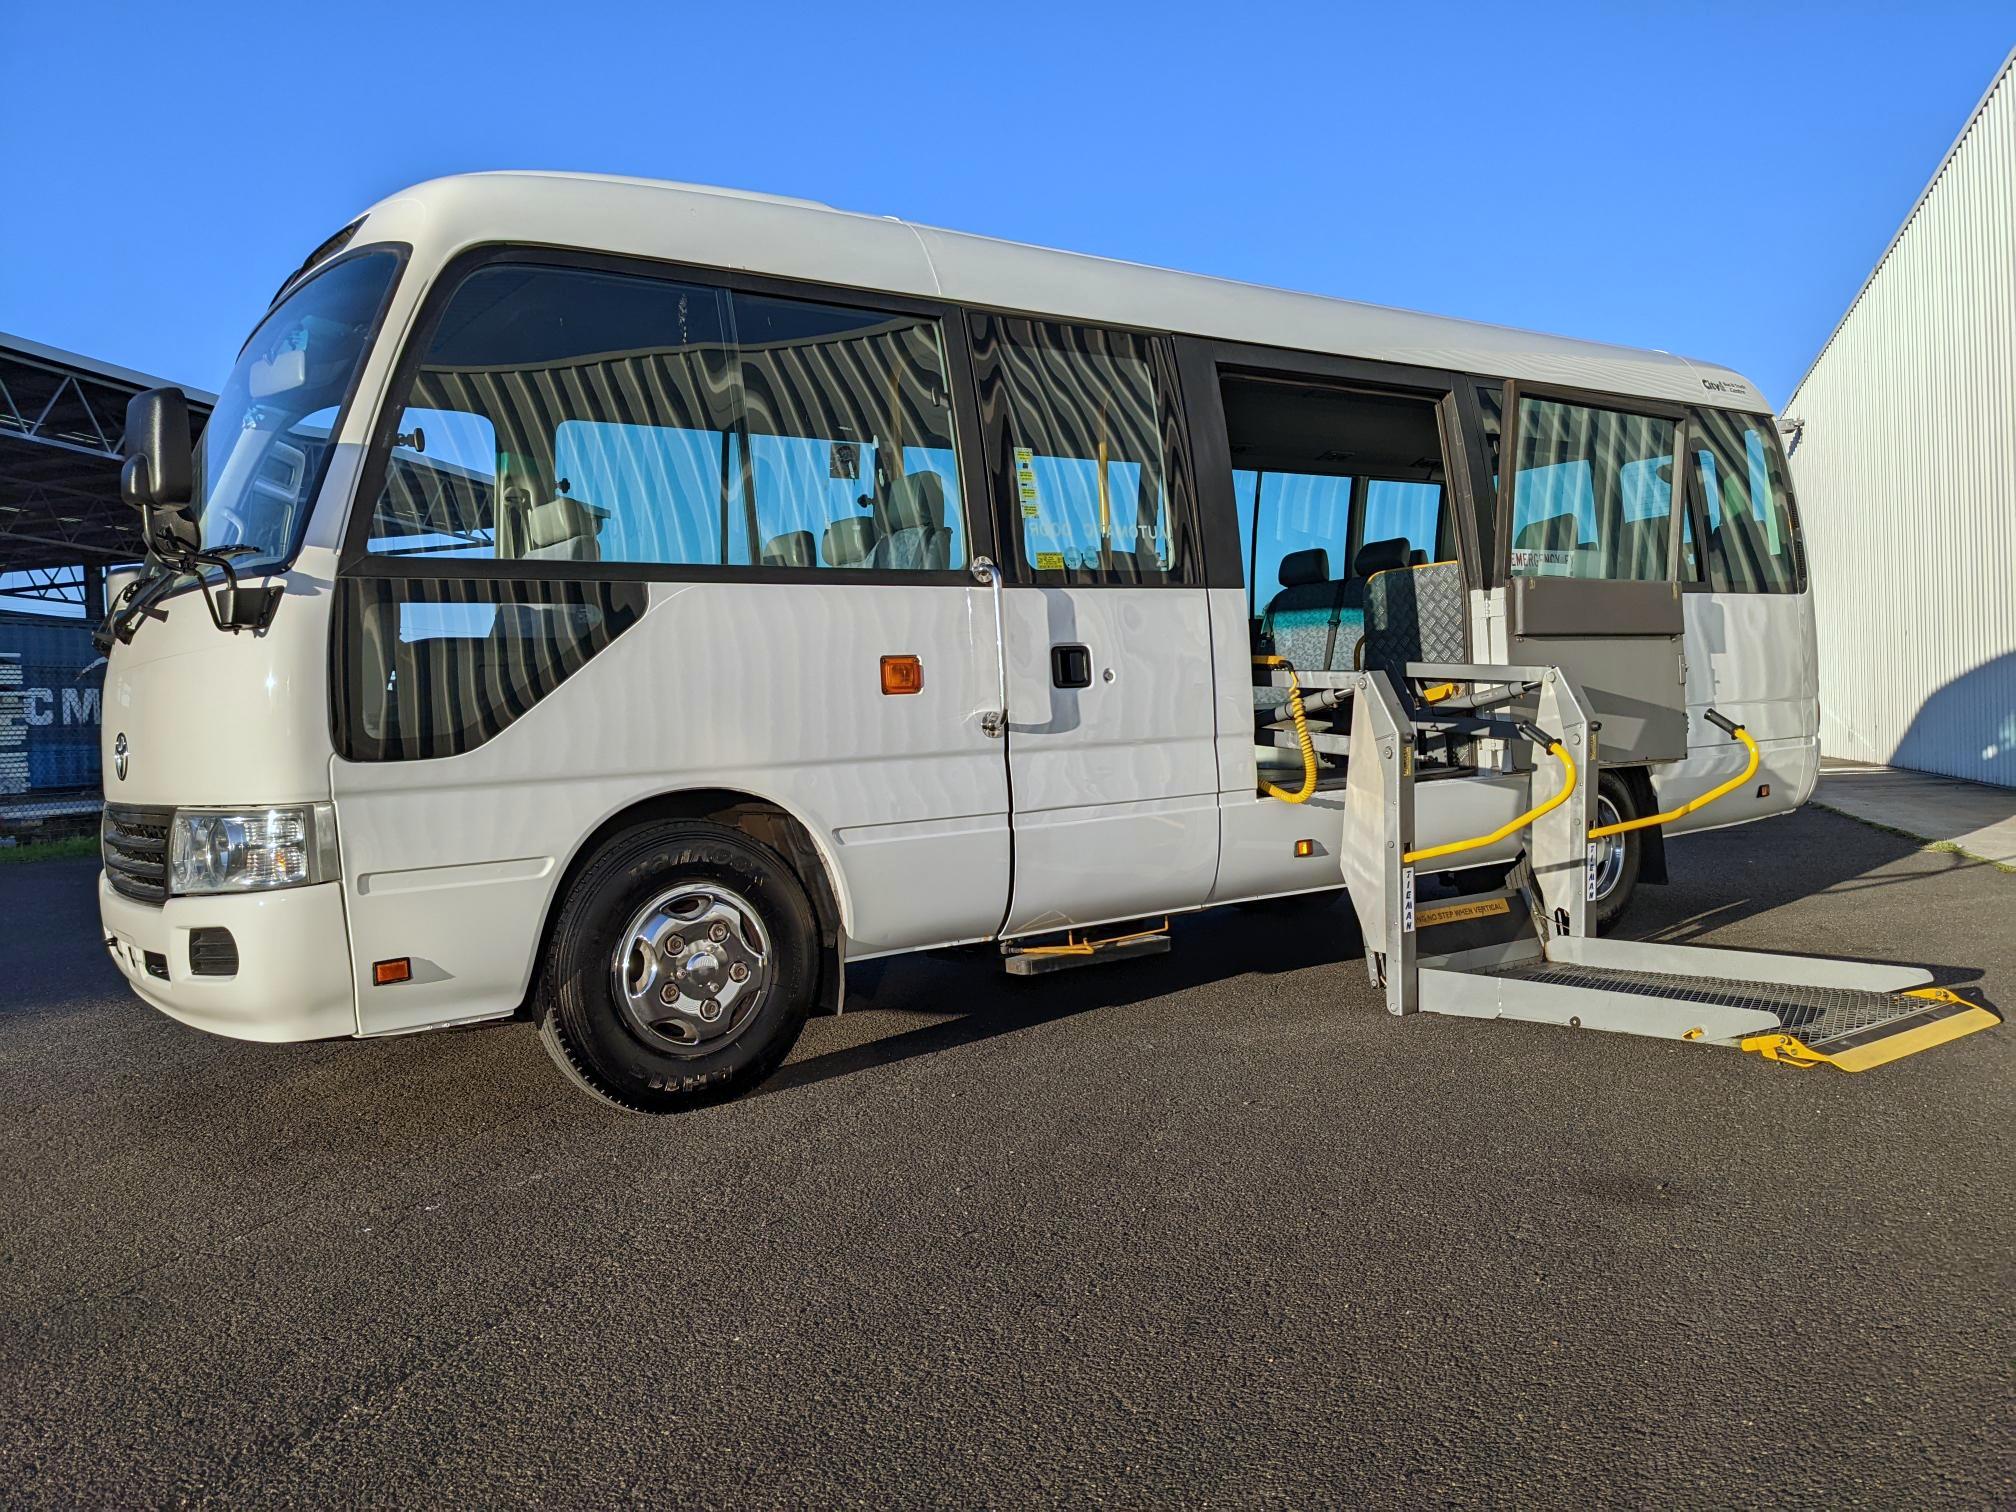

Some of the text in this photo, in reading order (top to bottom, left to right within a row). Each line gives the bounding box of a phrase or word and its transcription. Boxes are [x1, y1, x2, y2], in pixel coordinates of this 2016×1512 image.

[1702, 379, 1720, 392] City
[1511, 552, 1561, 567] EMERGENCY
[1405, 871, 1413, 930] TIEMAN
[1438, 911, 1454, 920] STEP
[1455, 907, 1473, 917] WHEN
